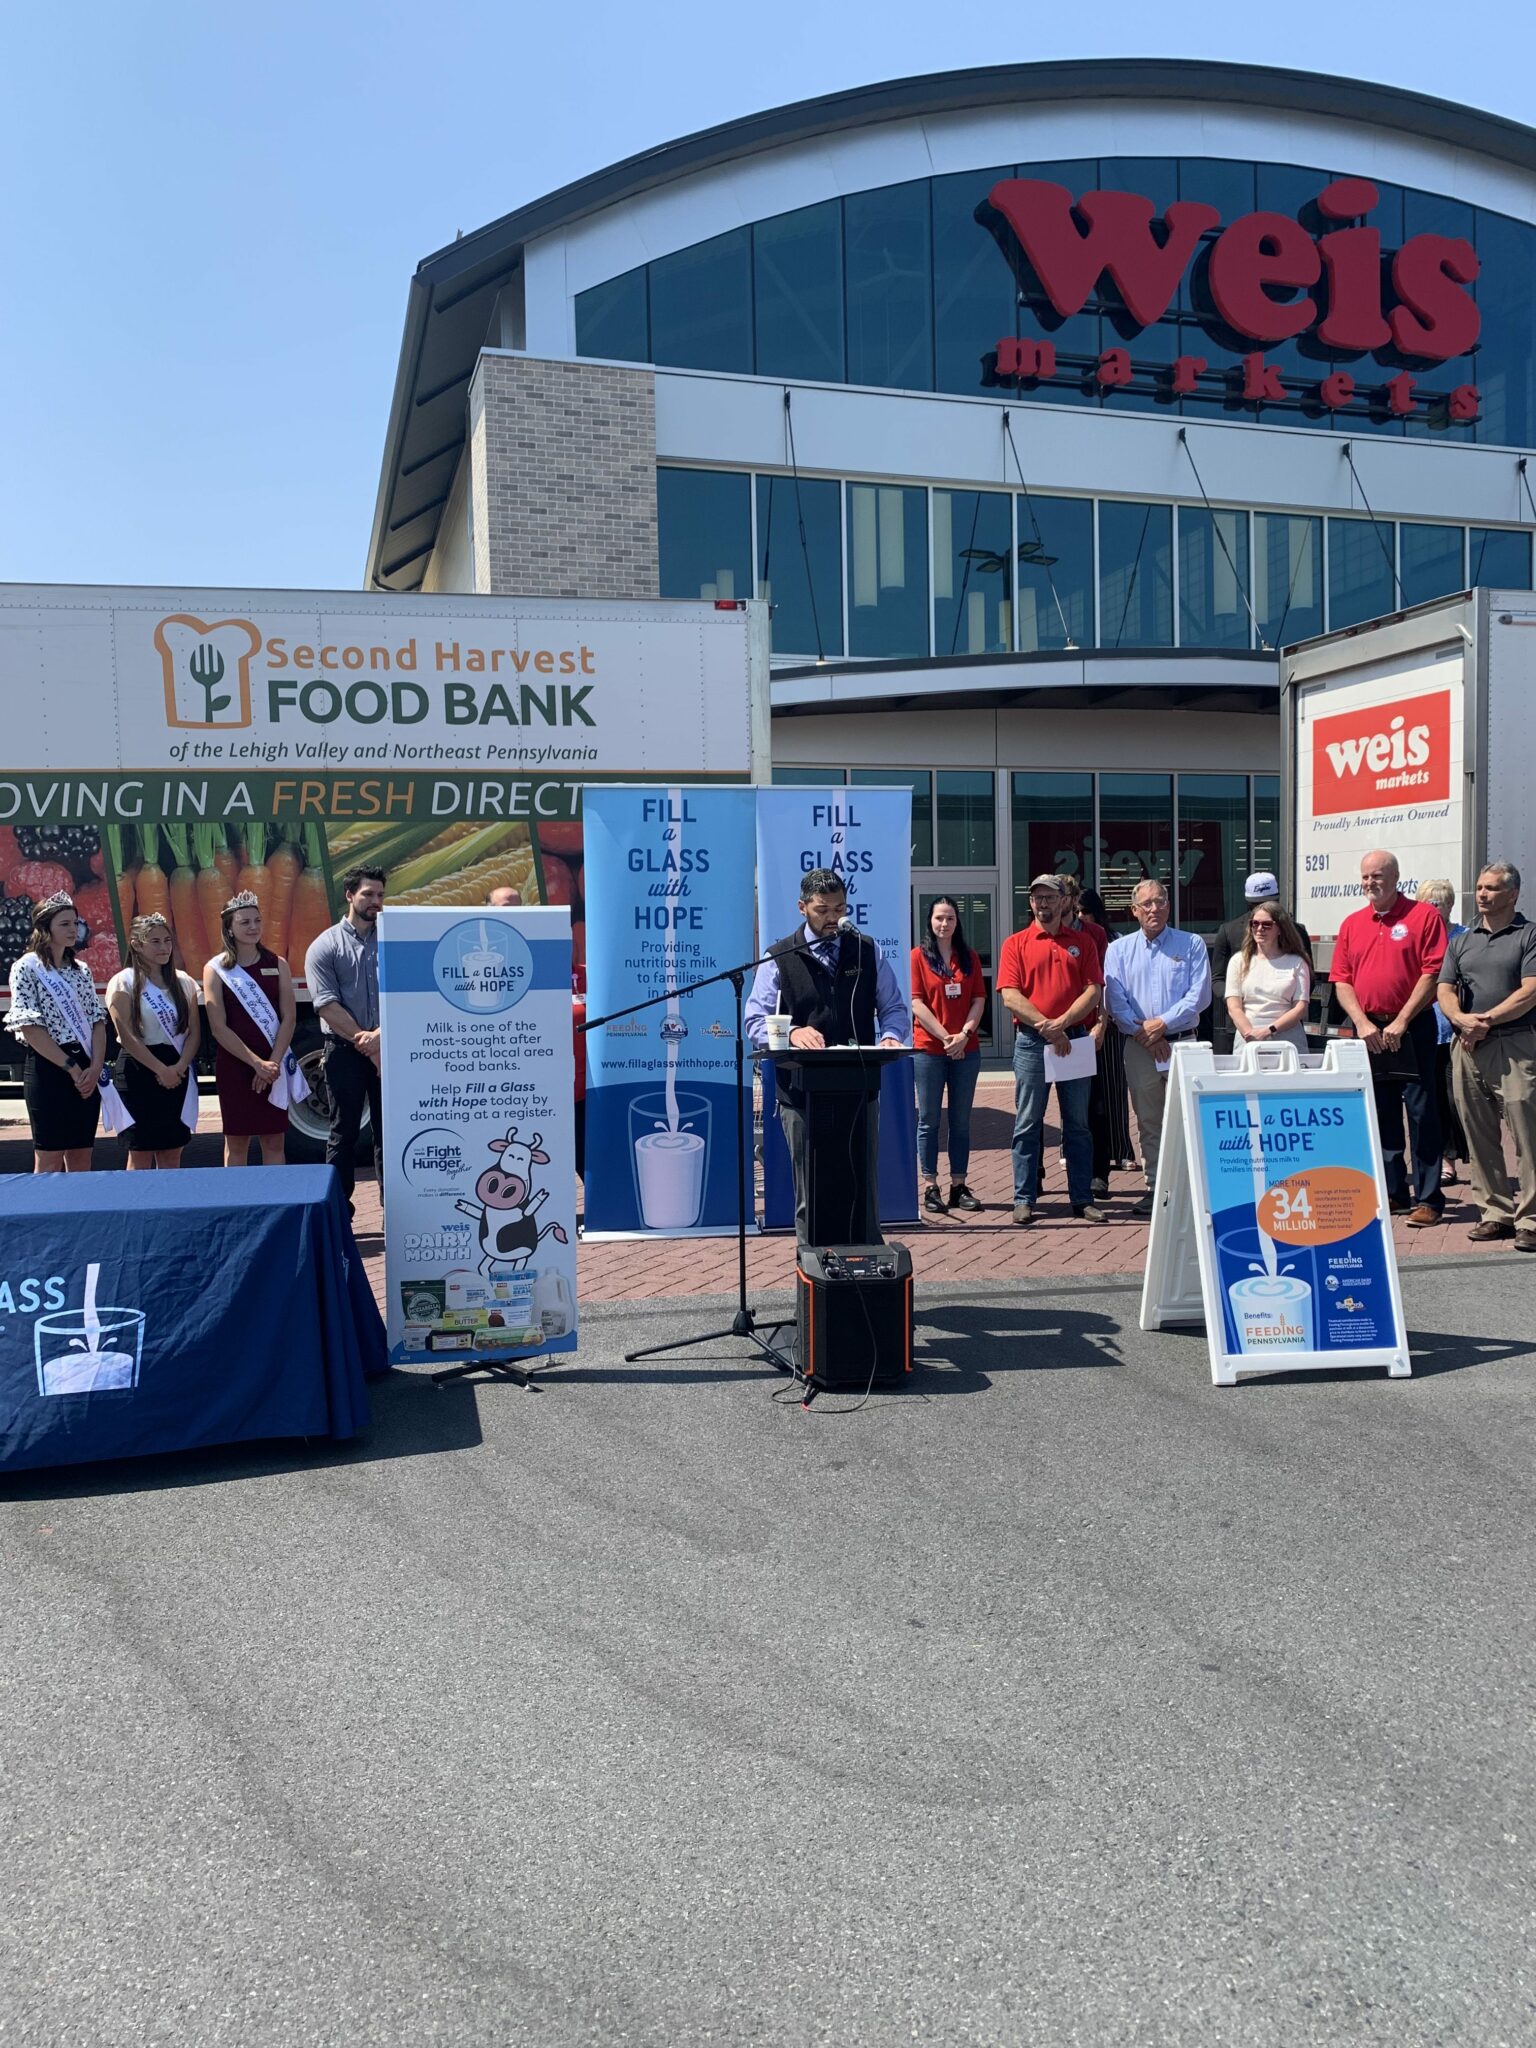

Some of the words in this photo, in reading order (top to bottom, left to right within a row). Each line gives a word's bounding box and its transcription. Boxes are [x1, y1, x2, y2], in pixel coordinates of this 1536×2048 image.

[988, 177, 1481, 360] weis
[995, 336, 1480, 420] markets
[266, 638, 417, 671] Second
[435, 642, 596, 674] Harvest
[267, 680, 430, 725] FOOD
[444, 682, 597, 727] BANK
[169, 741, 190, 761] of
[194, 742, 223, 758] the
[229, 742, 289, 762] Lehigh
[296, 742, 349, 762] Valley
[354, 743, 388, 758] and
[393, 744, 482, 759] Northeast
[487, 744, 598, 764] Pennsylvania
[1326, 715, 1430, 779] weis
[1376, 769, 1430, 791] markets
[161, 781, 208, 816] IN
[222, 781, 255, 816] A
[272, 780, 415, 816] FRESH
[643, 799, 697, 823] FILL
[813, 805, 861, 827] FILL
[1313, 817, 1352, 831] Proudly
[1353, 812, 1404, 827] American
[1408, 804, 1450, 820] Owned
[662, 827, 677, 841] a
[830, 831, 843, 844] a
[628, 848, 710, 873] GLASS
[1305, 854, 1330, 872] 5291
[648, 875, 692, 897] with
[635, 906, 704, 930] HOPE
[642, 941, 701, 956] Providing
[625, 957, 687, 968] nutritious
[690, 957, 717, 968] milk
[442, 967, 470, 979] FILL
[484, 966, 524, 978] GLASS
[637, 973, 650, 983] to
[654, 972, 704, 983] families
[454, 980, 476, 991] with
[480, 980, 514, 992] HOPE
[647, 987, 659, 998] in
[142, 992, 158, 1009] Dairy
[426, 1022, 454, 1033] Milk
[457, 1022, 467, 1032] is
[470, 1023, 495, 1032] one
[499, 1021, 512, 1031] of
[515, 1020, 537, 1031] the
[422, 1035, 507, 1048] most-sought
[509, 1033, 541, 1044] after
[410, 1049, 468, 1062] products
[471, 1048, 486, 1059] at
[490, 1047, 520, 1058] local
[523, 1048, 554, 1057] area
[445, 1061, 474, 1072] food
[479, 1060, 521, 1071] banks.
[601, 1058, 739, 1071] www.fillaglasswithhope.org
[431, 1084, 461, 1096] Help
[466, 1082, 485, 1094] Fill
[488, 1084, 497, 1093] a
[500, 1081, 536, 1093] Glass
[419, 1097, 448, 1108] with
[452, 1096, 488, 1109] Hope
[490, 1095, 529, 1107] today
[532, 1094, 548, 1106] by
[410, 1110, 470, 1122] donating
[474, 1110, 488, 1120] at
[492, 1111, 500, 1119] a
[504, 1107, 556, 1120] register.
[1215, 1109, 1259, 1129] FILL
[1264, 1114, 1275, 1125] a
[1280, 1107, 1345, 1128] GLASS
[1219, 1132, 1253, 1151] with
[1259, 1132, 1314, 1152] HOPE
[427, 1144, 462, 1159] Fight
[412, 1158, 462, 1172] Hunger
[1219, 1157, 1249, 1165] Providing
[1269, 1180, 1289, 1188] MORE
[1291, 1179, 1311, 1187] THAN
[1270, 1187, 1313, 1220] 34
[441, 1222, 470, 1232] weis
[1273, 1219, 1316, 1232] MILLION
[404, 1231, 471, 1249] DAIRY
[404, 1246, 471, 1262] MONTH
[1245, 1325, 1304, 1337] FEEDING
[1247, 1336, 1306, 1345] PENNSYLVANIA
